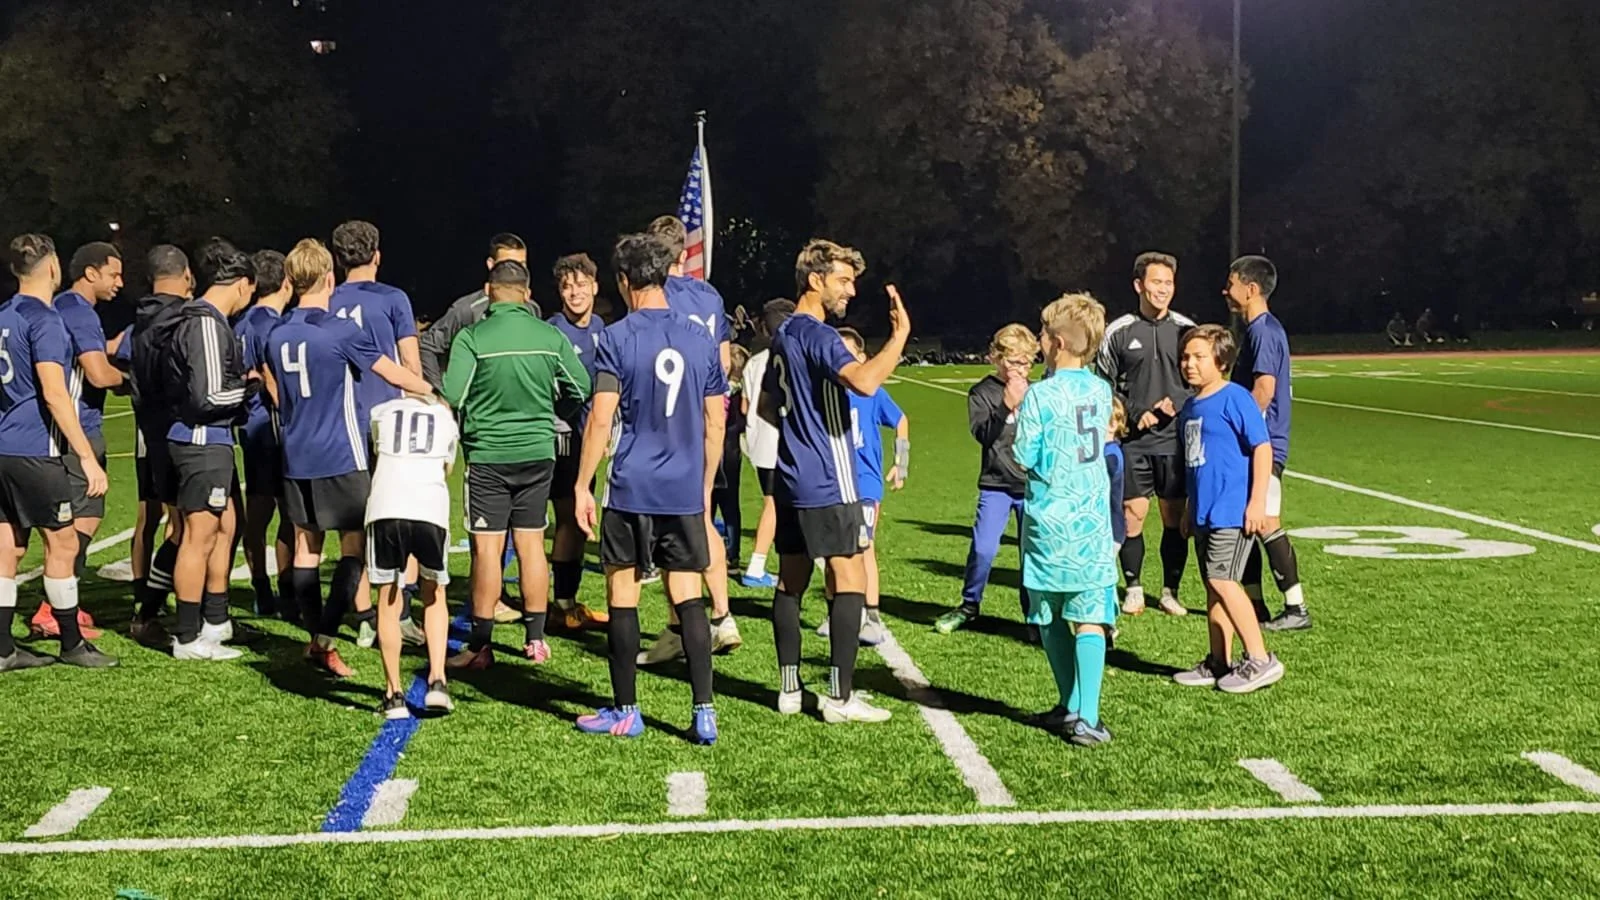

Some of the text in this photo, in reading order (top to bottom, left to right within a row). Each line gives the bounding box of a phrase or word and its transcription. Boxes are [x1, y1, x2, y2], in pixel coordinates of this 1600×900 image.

[281, 341, 311, 398] 4
[655, 348, 685, 417] 9
[773, 354, 793, 417] 3
[391, 409, 435, 454] 10
[1075, 403, 1099, 463] 5
[1286, 525, 1537, 559] 3
